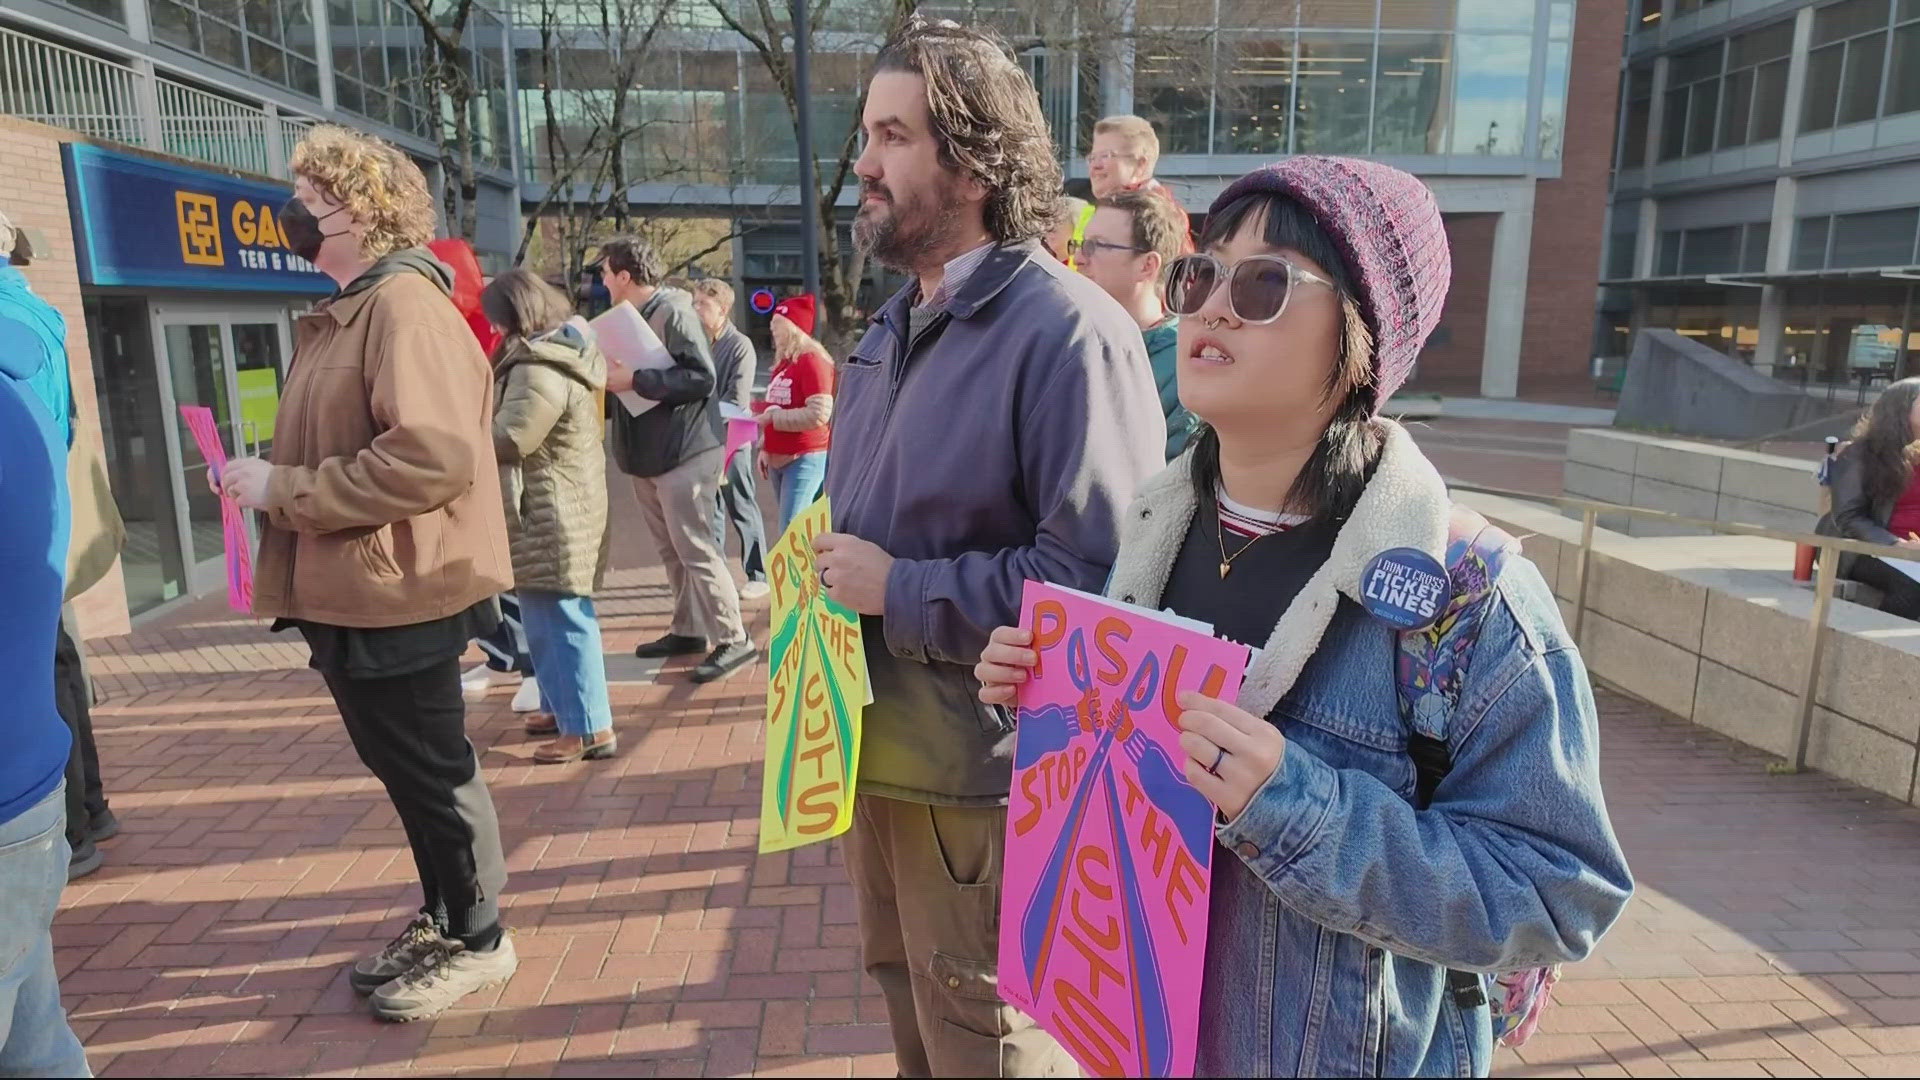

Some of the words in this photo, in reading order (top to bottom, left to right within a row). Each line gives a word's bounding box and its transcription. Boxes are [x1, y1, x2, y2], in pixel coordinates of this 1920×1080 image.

[232, 200, 291, 250] GA
[238, 249, 268, 269] TEA
[1366, 581, 1436, 618] LINES
[1372, 568, 1442, 602] PICKET
[1377, 558, 1383, 569] I
[1383, 559, 1413, 578] DON'T
[1412, 568, 1446, 591] CROSS
[772, 622, 805, 724] STOP
[818, 612, 860, 681] THE
[797, 672, 840, 835] CUTS
[1014, 745, 1087, 837] STOP
[1121, 770, 1207, 946] THE
[1051, 845, 1132, 1077] CUTS
